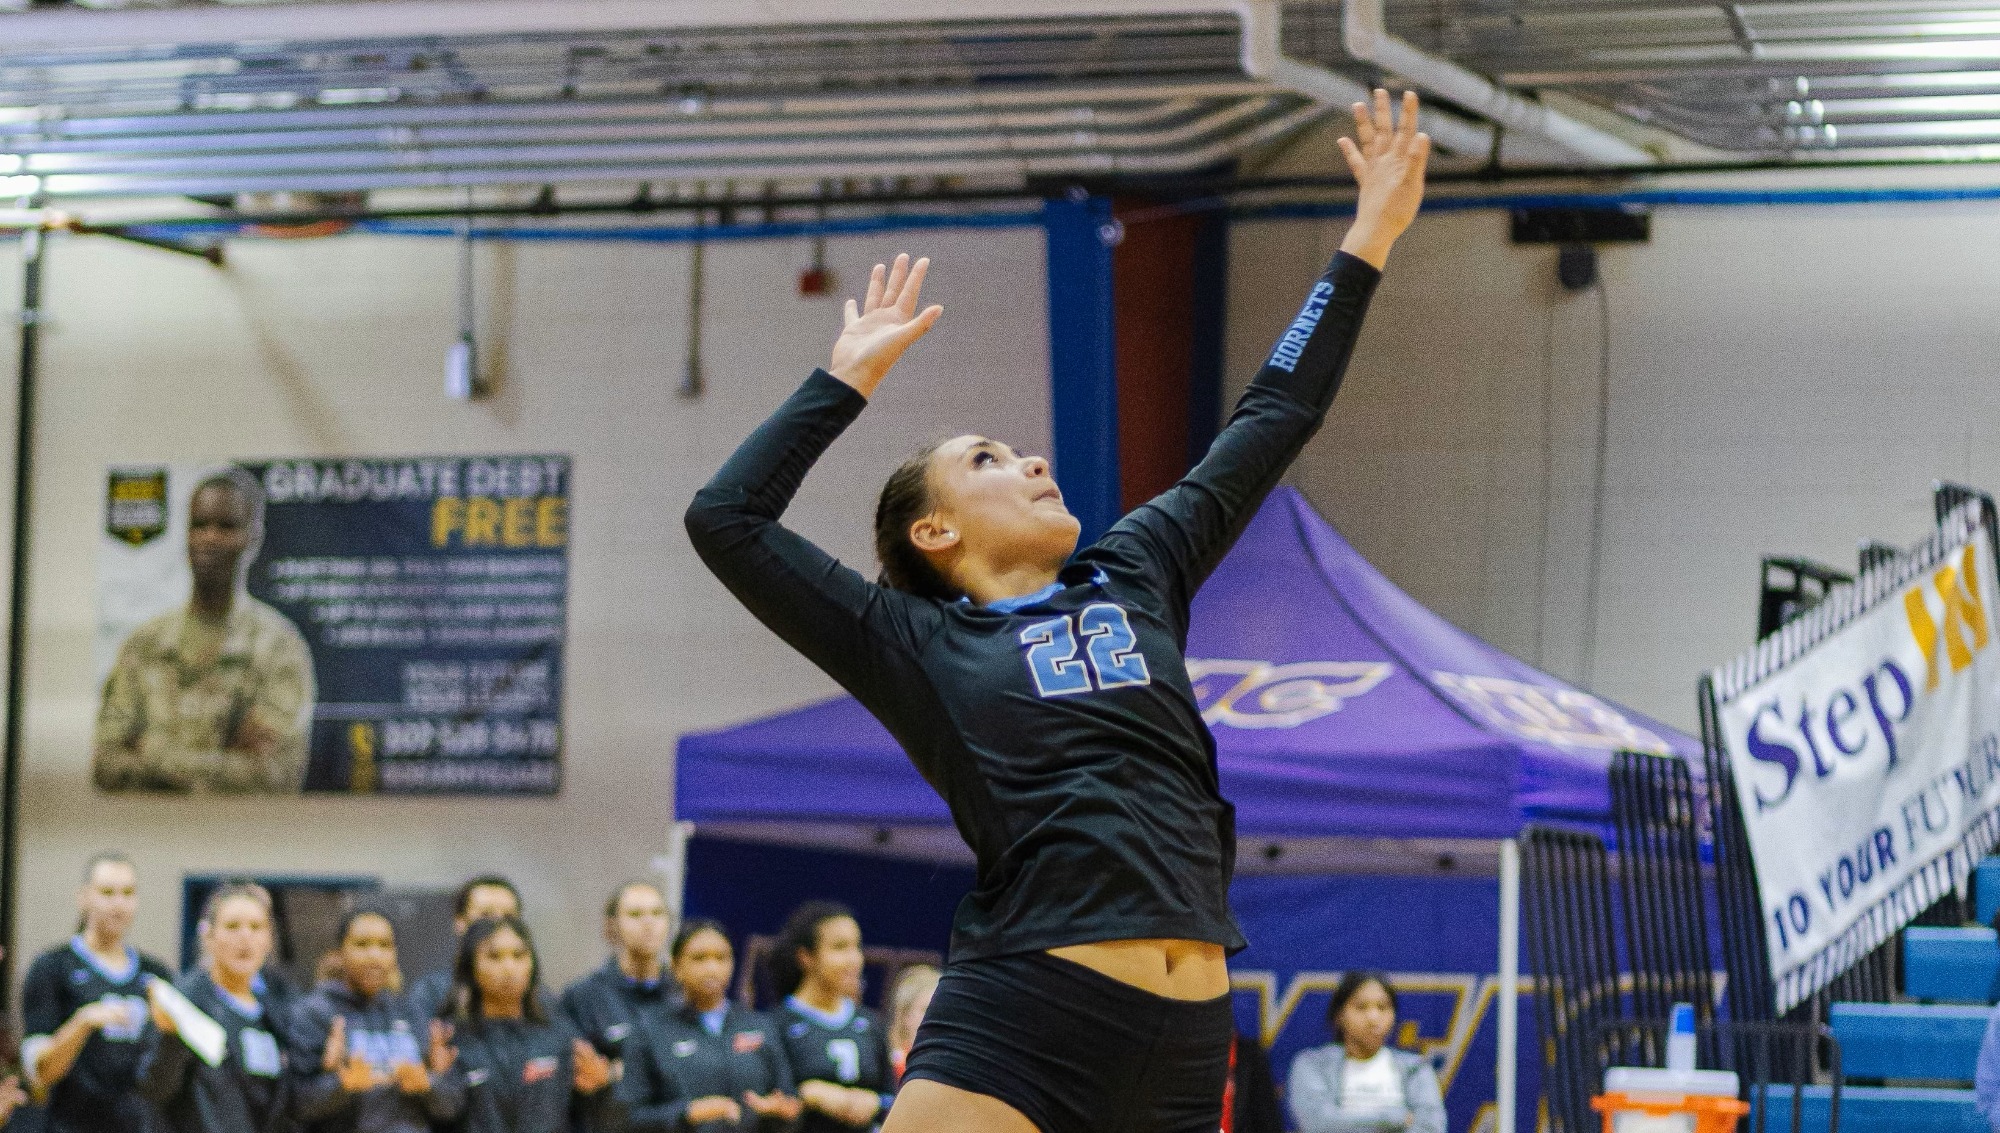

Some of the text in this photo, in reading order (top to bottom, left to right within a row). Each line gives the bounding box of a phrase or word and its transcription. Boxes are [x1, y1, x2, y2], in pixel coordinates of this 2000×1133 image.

[1268, 281, 1335, 373] HORNETS
[266, 458, 564, 502] GRADUATE DEBT
[432, 496, 567, 548] FREE
[1019, 602, 1151, 697] 22
[1746, 656, 1915, 815] Step
[1819, 828, 1897, 910] YOUR
